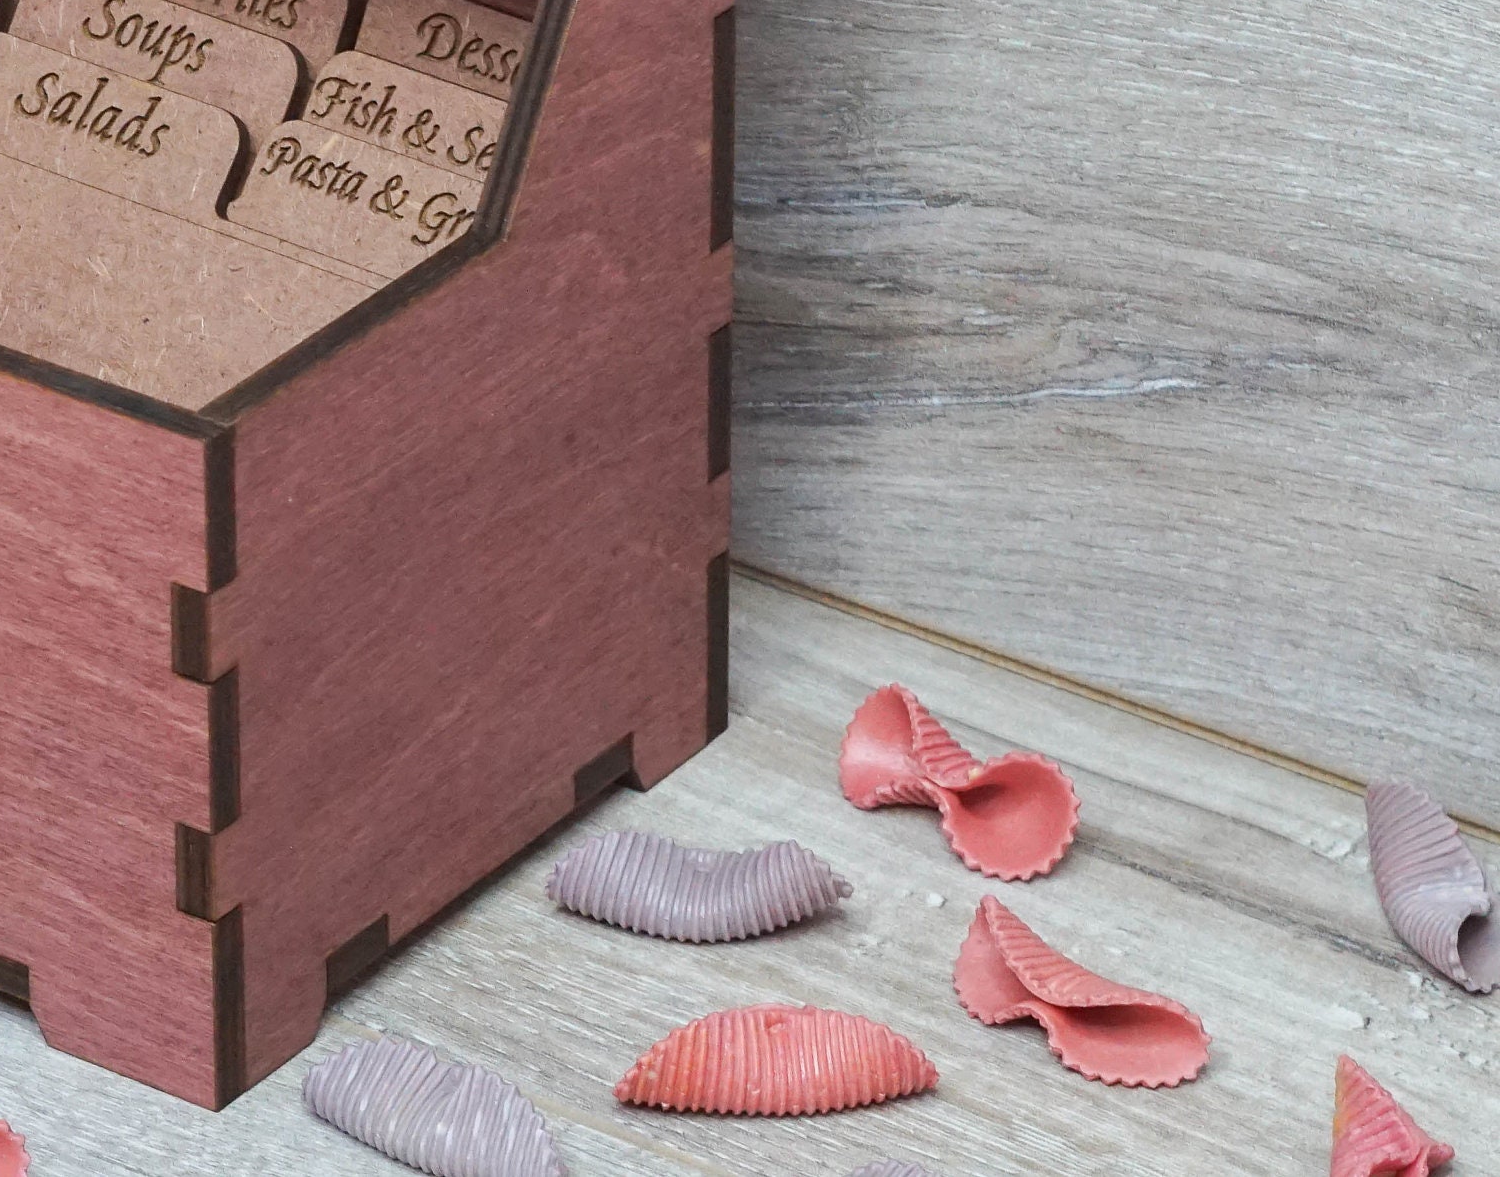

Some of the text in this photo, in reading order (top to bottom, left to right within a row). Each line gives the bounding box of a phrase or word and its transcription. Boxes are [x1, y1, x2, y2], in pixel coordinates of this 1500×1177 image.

[416, 12, 520, 86] Dess
[14, 72, 171, 159] Salads
[311, 76, 397, 139] Fish
[402, 109, 441, 155] &
[258, 136, 367, 203] Pasta
[370, 175, 410, 221] &
